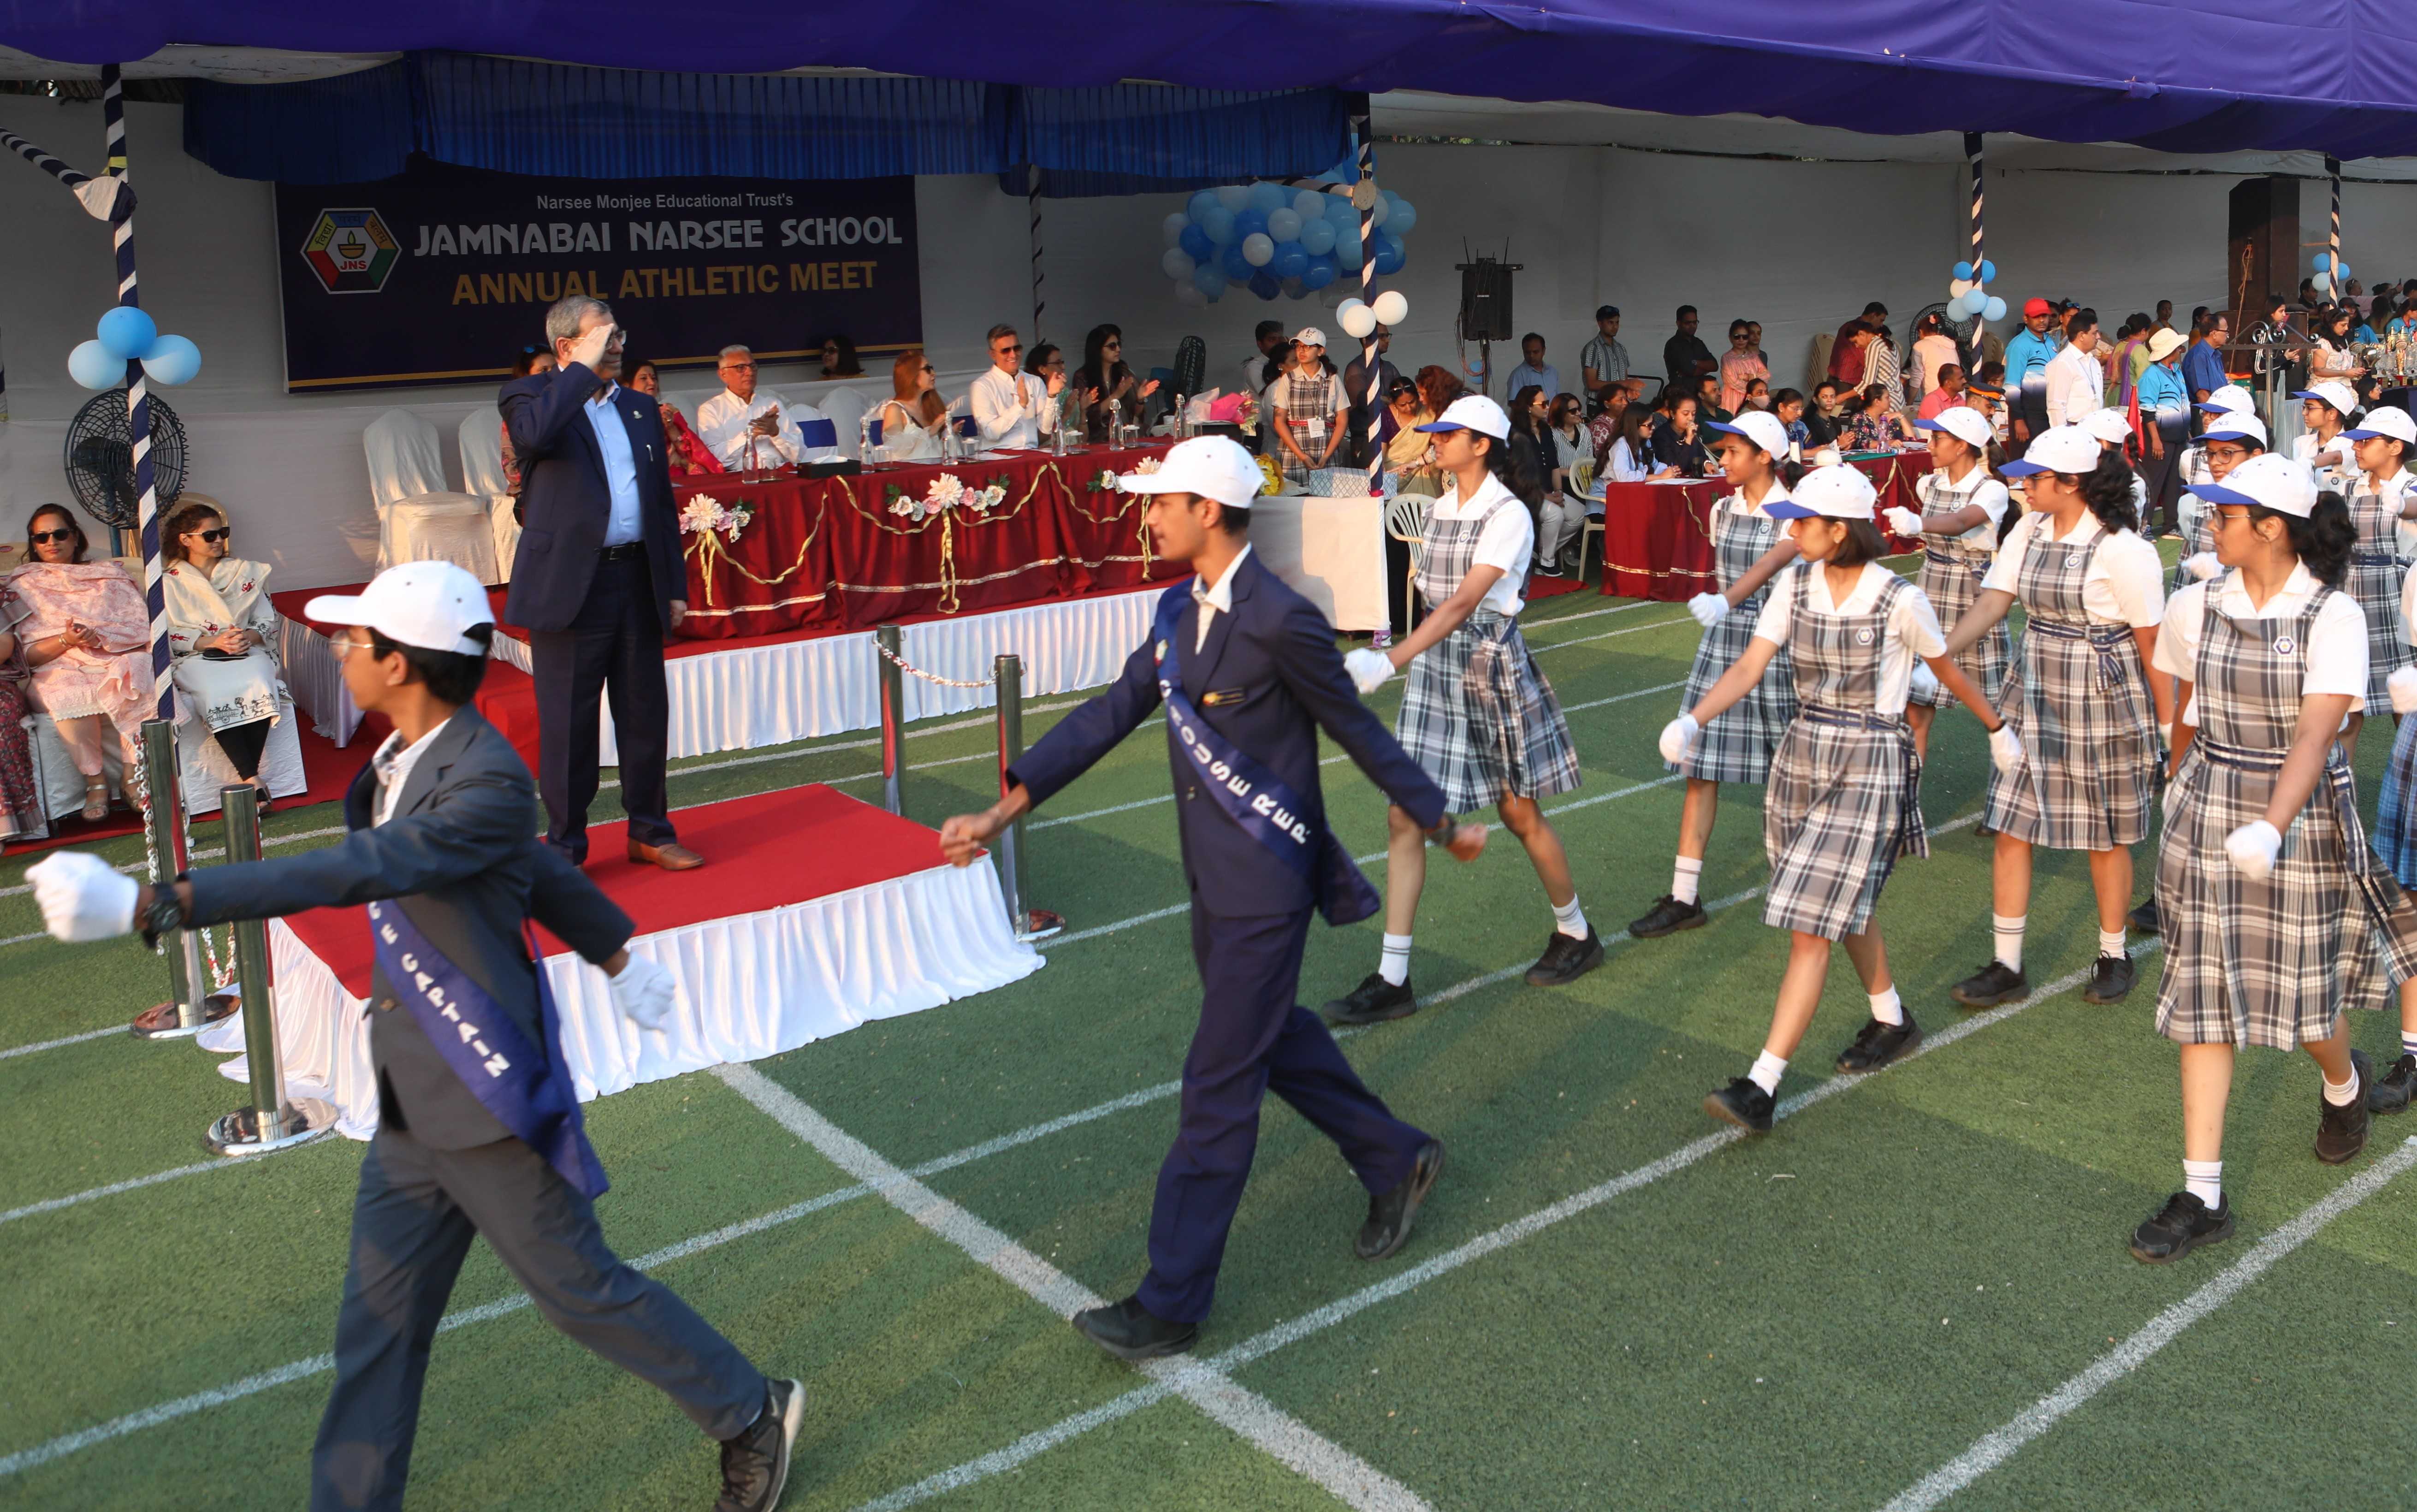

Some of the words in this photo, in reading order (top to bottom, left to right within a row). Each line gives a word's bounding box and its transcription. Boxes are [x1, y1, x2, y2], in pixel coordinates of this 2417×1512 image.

[537, 195, 592, 209] Narsee
[597, 194, 651, 211] Monjee
[656, 194, 742, 208] Educational
[746, 193, 794, 206] Trust's
[414, 222, 611, 256] JAMNABAI
[629, 219, 764, 251] NARSEE
[780, 216, 902, 247] SCHOOL
[340, 260, 367, 270] JNS
[452, 271, 609, 305] ANNUAL
[619, 265, 779, 299] ATHLETIC
[790, 261, 877, 291] MEET
[1169, 705, 1251, 797] HOUSE
[1251, 793, 1311, 844] REP.
[401, 953, 511, 1078] CAPTAIN
